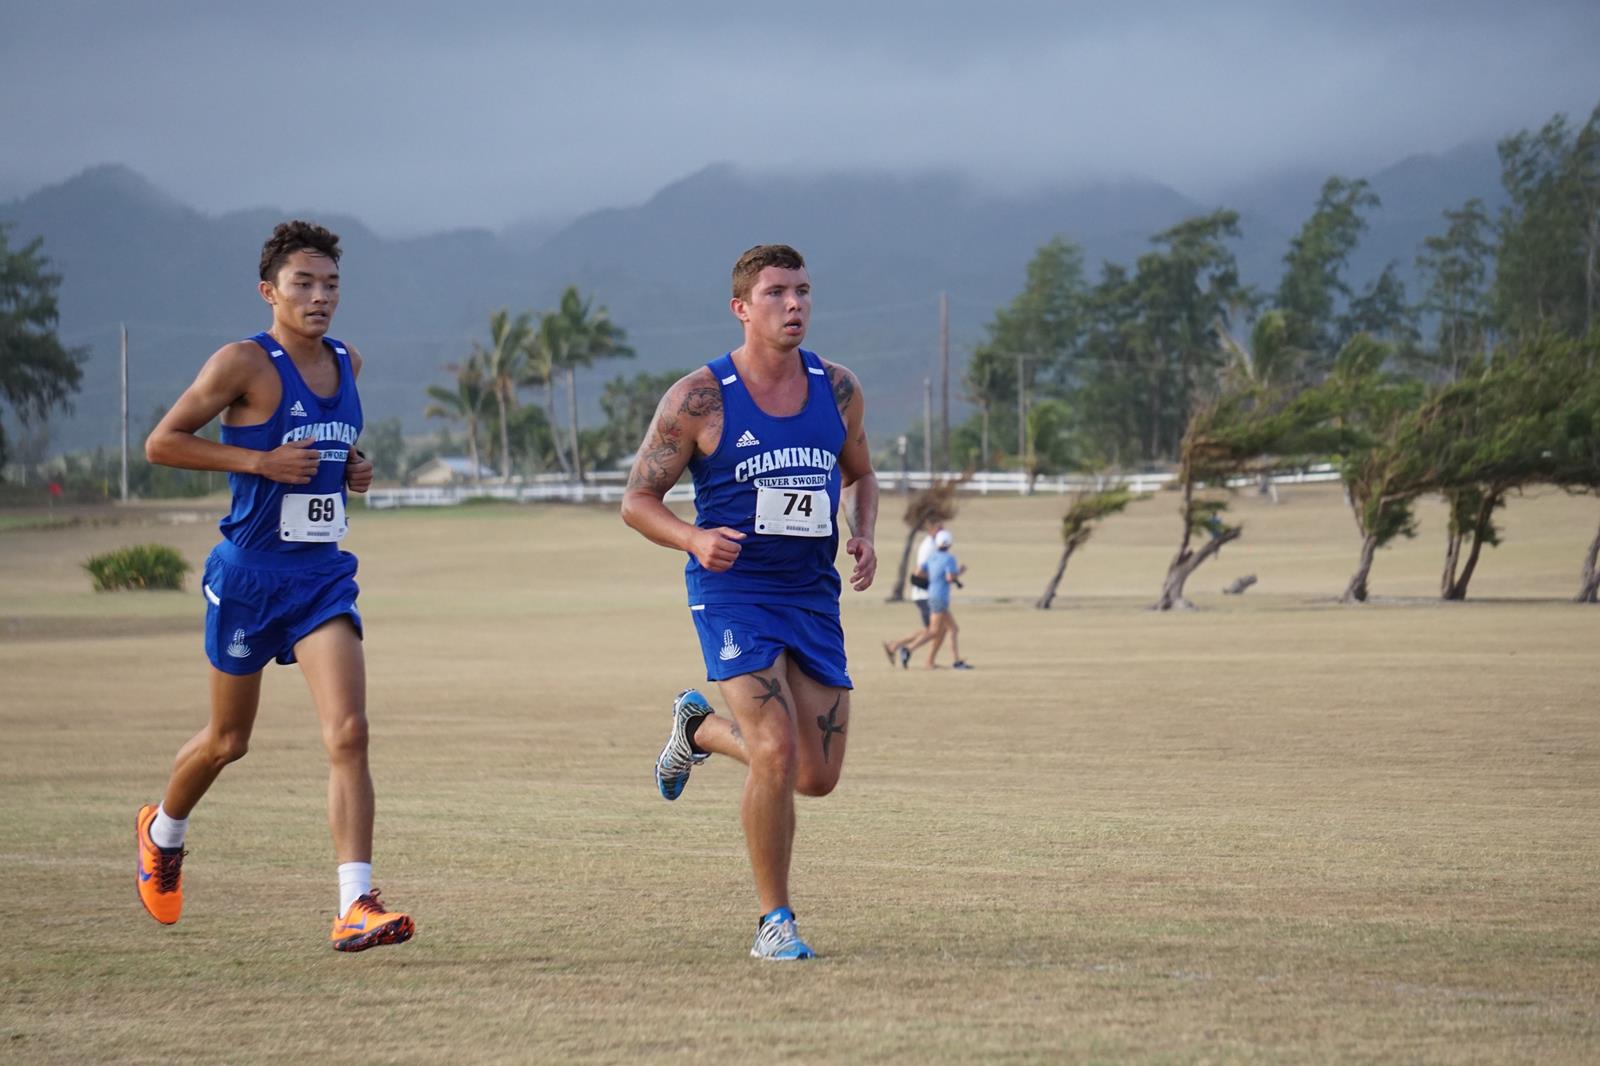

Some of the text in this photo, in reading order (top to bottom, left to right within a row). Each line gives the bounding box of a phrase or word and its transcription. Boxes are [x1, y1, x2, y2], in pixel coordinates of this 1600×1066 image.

[758, 475, 825, 487] SILVER SWORDS
[308, 498, 335, 522] 69
[783, 493, 812, 517] 74
